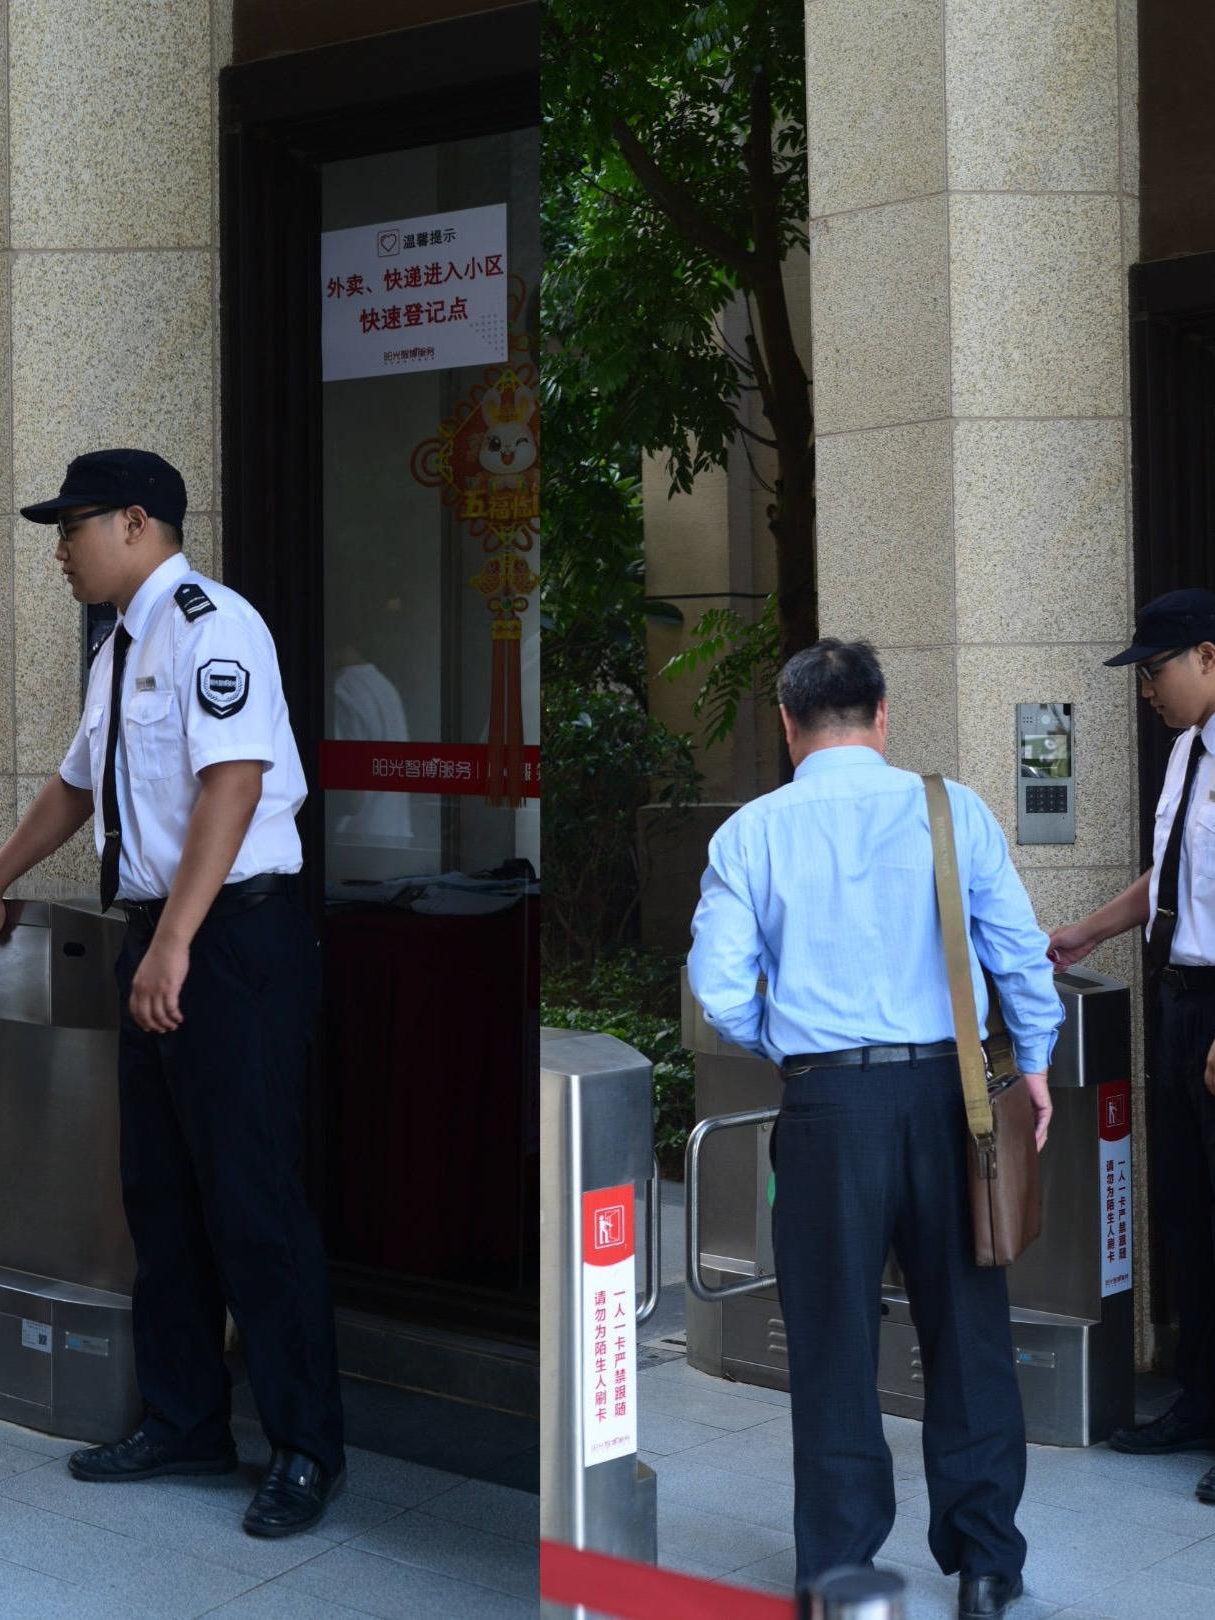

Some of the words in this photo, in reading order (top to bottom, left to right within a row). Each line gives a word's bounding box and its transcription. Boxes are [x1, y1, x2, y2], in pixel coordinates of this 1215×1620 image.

[402, 228, 457, 250] 温馨提示
[326, 253, 504, 299] 外卖、快递进入小区
[359, 296, 469, 334] 快速登记点
[372, 757, 472, 780] 阳光智博服务
[594, 1289, 607, 1424] 请勿为陌生人刷卡
[614, 1290, 626, 1416] 一人一卡严禁跟随
